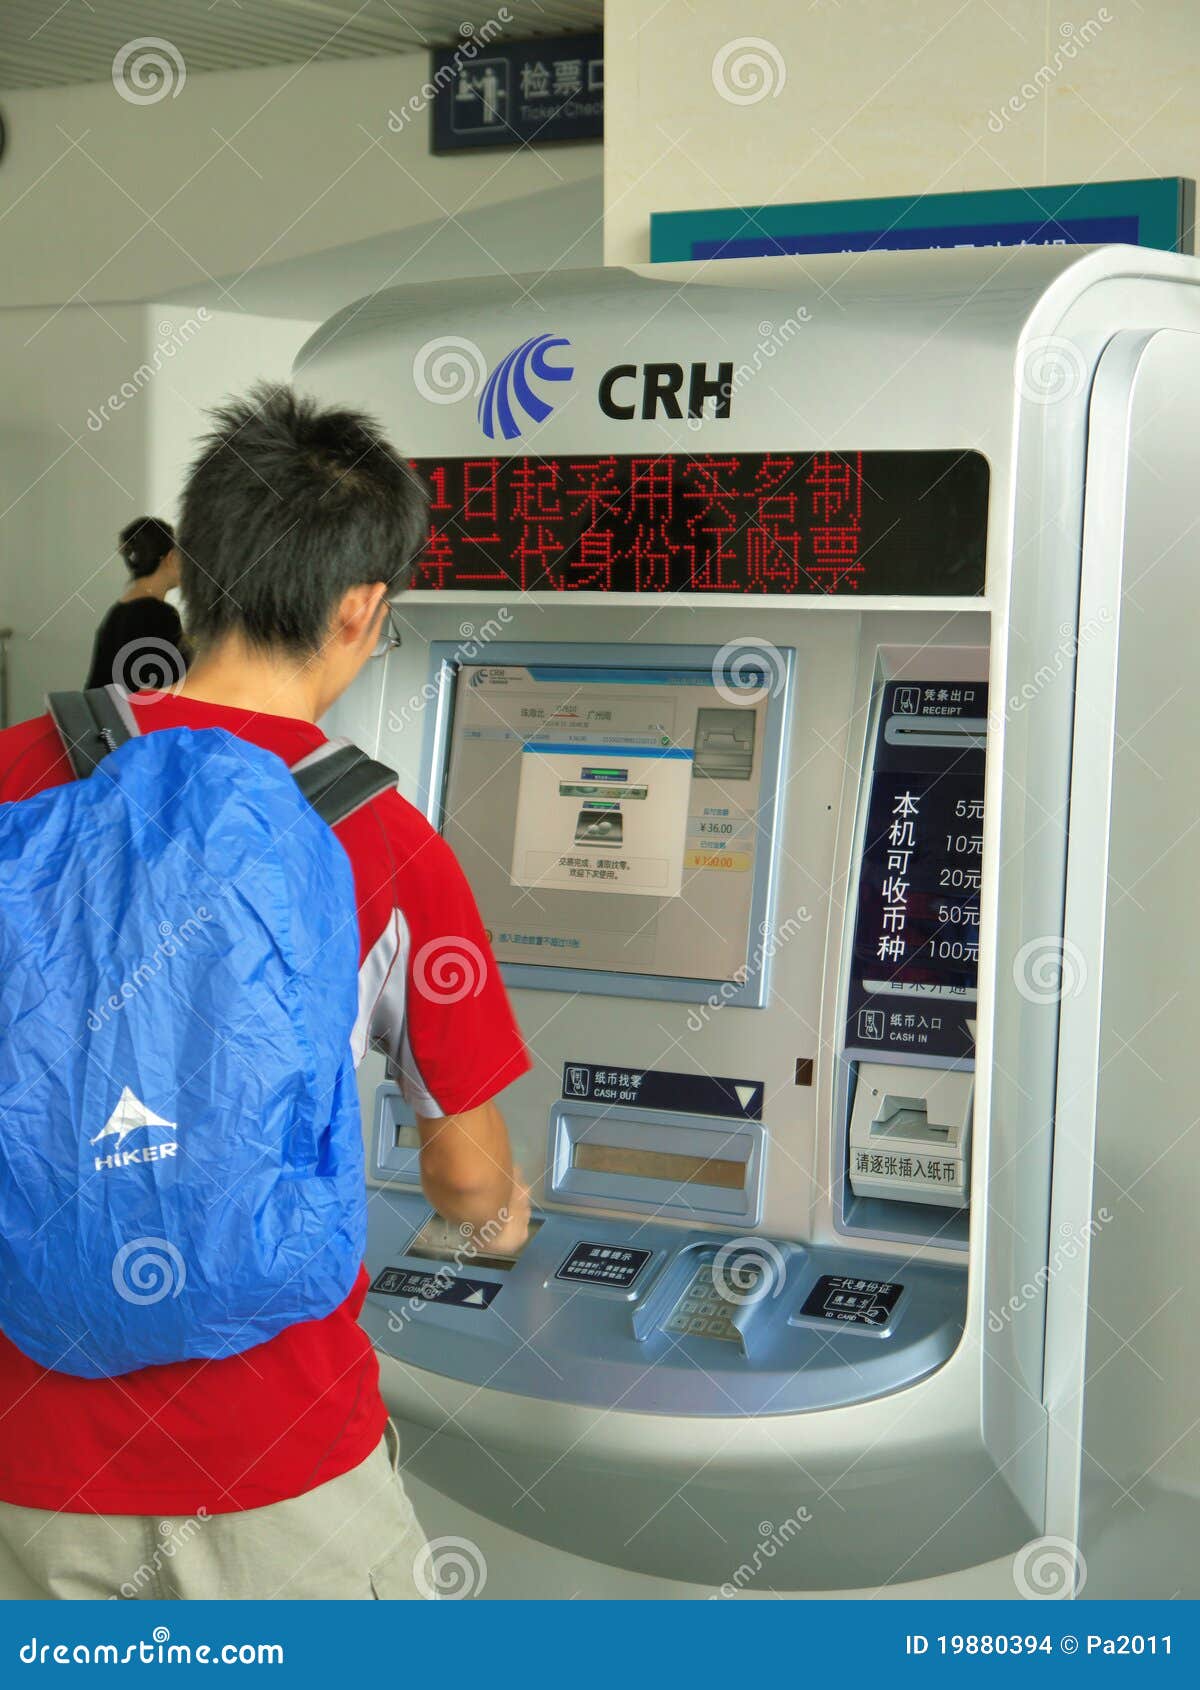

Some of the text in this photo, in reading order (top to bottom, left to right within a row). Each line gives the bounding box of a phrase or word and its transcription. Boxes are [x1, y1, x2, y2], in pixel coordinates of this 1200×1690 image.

[598, 361, 733, 420] CRH
[408, 451, 862, 525] 1日起采用实名制
[924, 689, 975, 702] 凭条出口
[922, 706, 963, 716] RECEIPT
[955, 800, 985, 820] 5元
[946, 835, 984, 854] 10元
[876, 791, 921, 962] 本机可收币种
[939, 869, 982, 889] 20元
[938, 905, 980, 926] 50元
[929, 940, 979, 962] 100元
[889, 1013, 942, 1030] 纸币入口
[889, 1032, 928, 1043] CASH IN
[594, 1071, 642, 1089] 纸币找零
[594, 1088, 637, 1101] CASH OUT
[94, 1142, 178, 1171] HIKER
[855, 1152, 956, 1183] 请逐张插入纸币
[828, 1278, 893, 1294] 二代身份证
